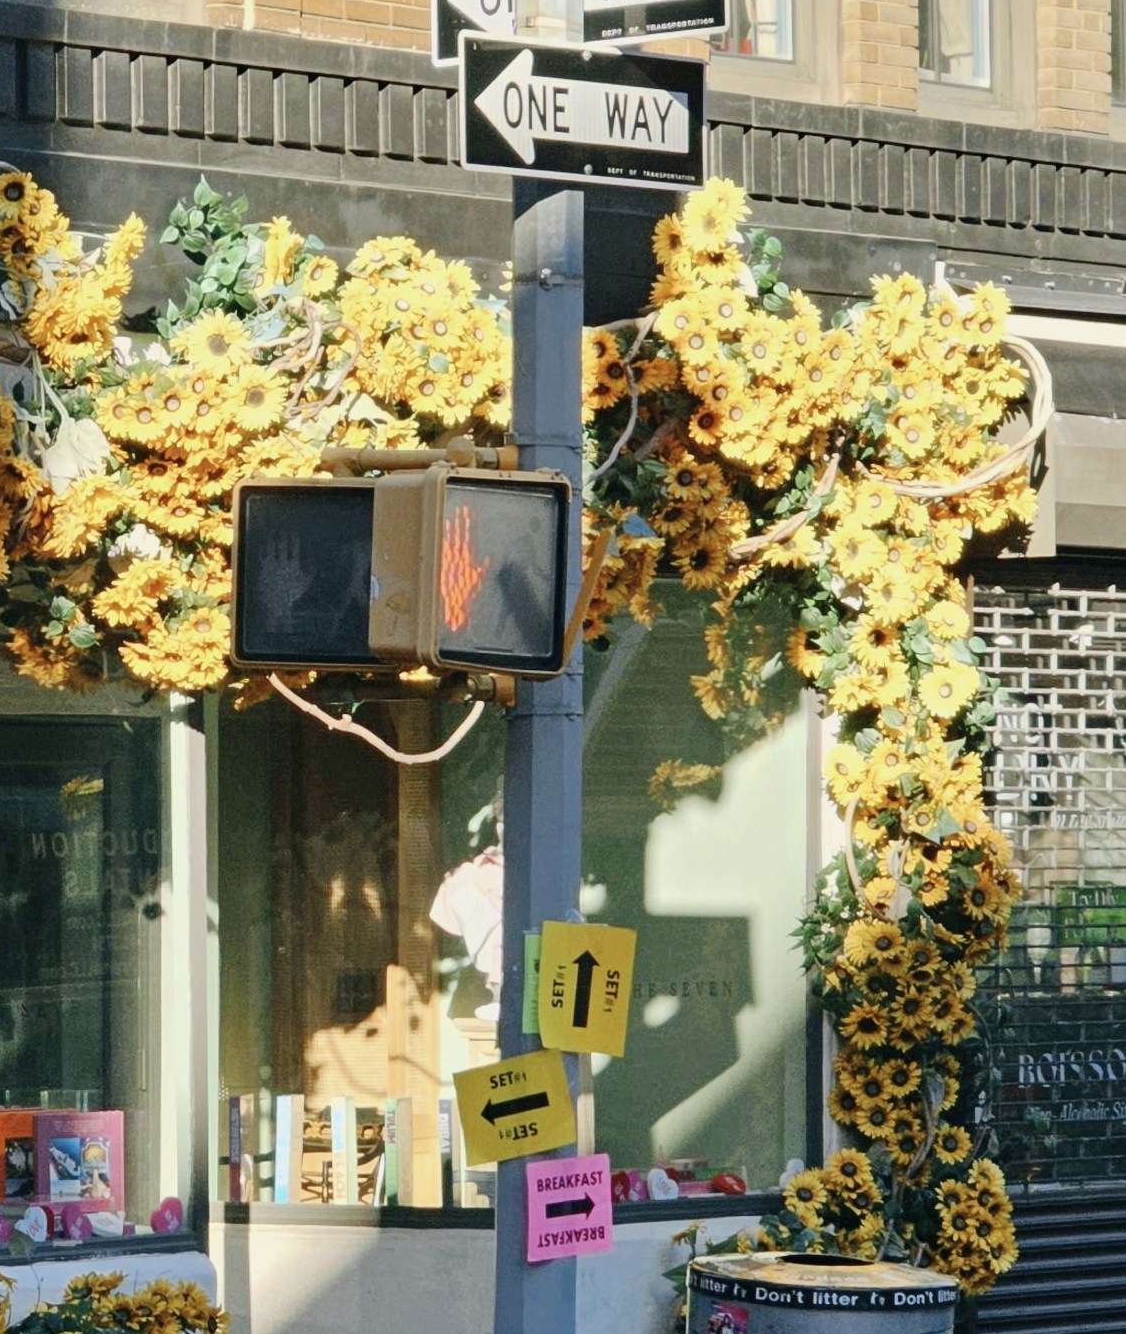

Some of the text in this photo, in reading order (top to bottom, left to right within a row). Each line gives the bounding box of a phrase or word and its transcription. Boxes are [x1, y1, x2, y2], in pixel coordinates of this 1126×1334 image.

[503, 79, 674, 144] ONE WAY
[669, 980, 733, 998] SEVEN
[386, 1110, 396, 1145] TULUM
[536, 1170, 603, 1193] BREAKFAST
[537, 1225, 606, 1248] BREAKFAST
[755, 1286, 859, 1307] Don't litter
[894, 1290, 934, 1306] Don't
